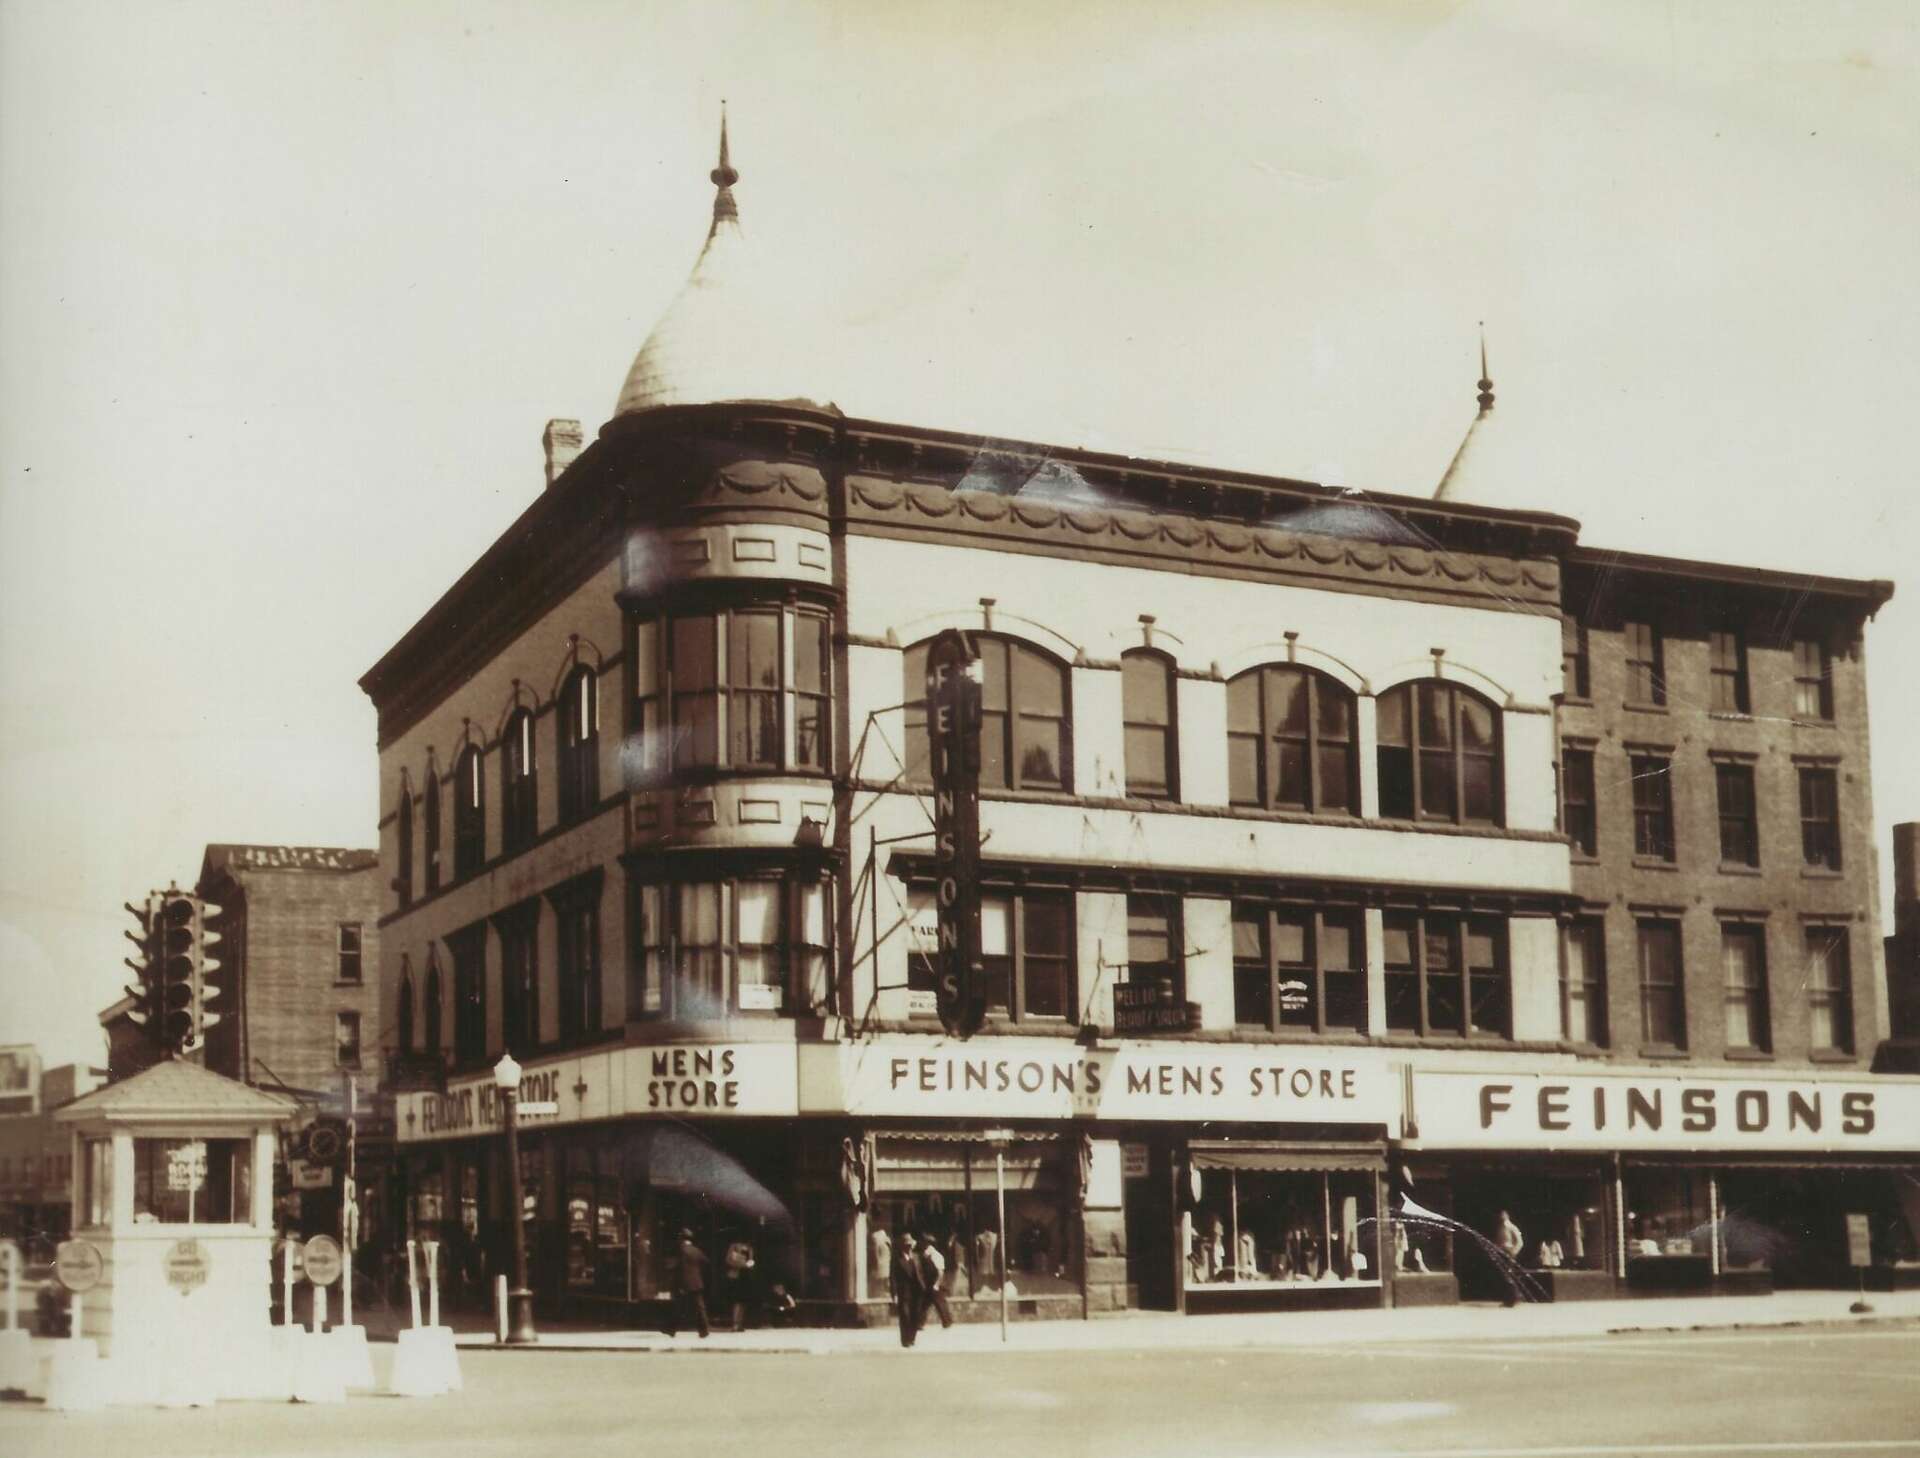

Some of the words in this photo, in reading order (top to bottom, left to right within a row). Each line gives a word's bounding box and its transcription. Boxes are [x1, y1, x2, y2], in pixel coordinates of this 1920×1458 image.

[936, 663, 959, 1002] FEINSONS
[651, 1048, 735, 1077] MENS
[891, 1058, 1101, 1095] FEINSON'S
[1128, 1065, 1224, 1095] MENS
[1249, 1067, 1356, 1098] STORE
[648, 1079, 739, 1108] STORE
[1480, 1085, 1876, 1135] FEINSONS
[177, 1240, 198, 1256] GO
[169, 1270, 206, 1285] RIGHT
